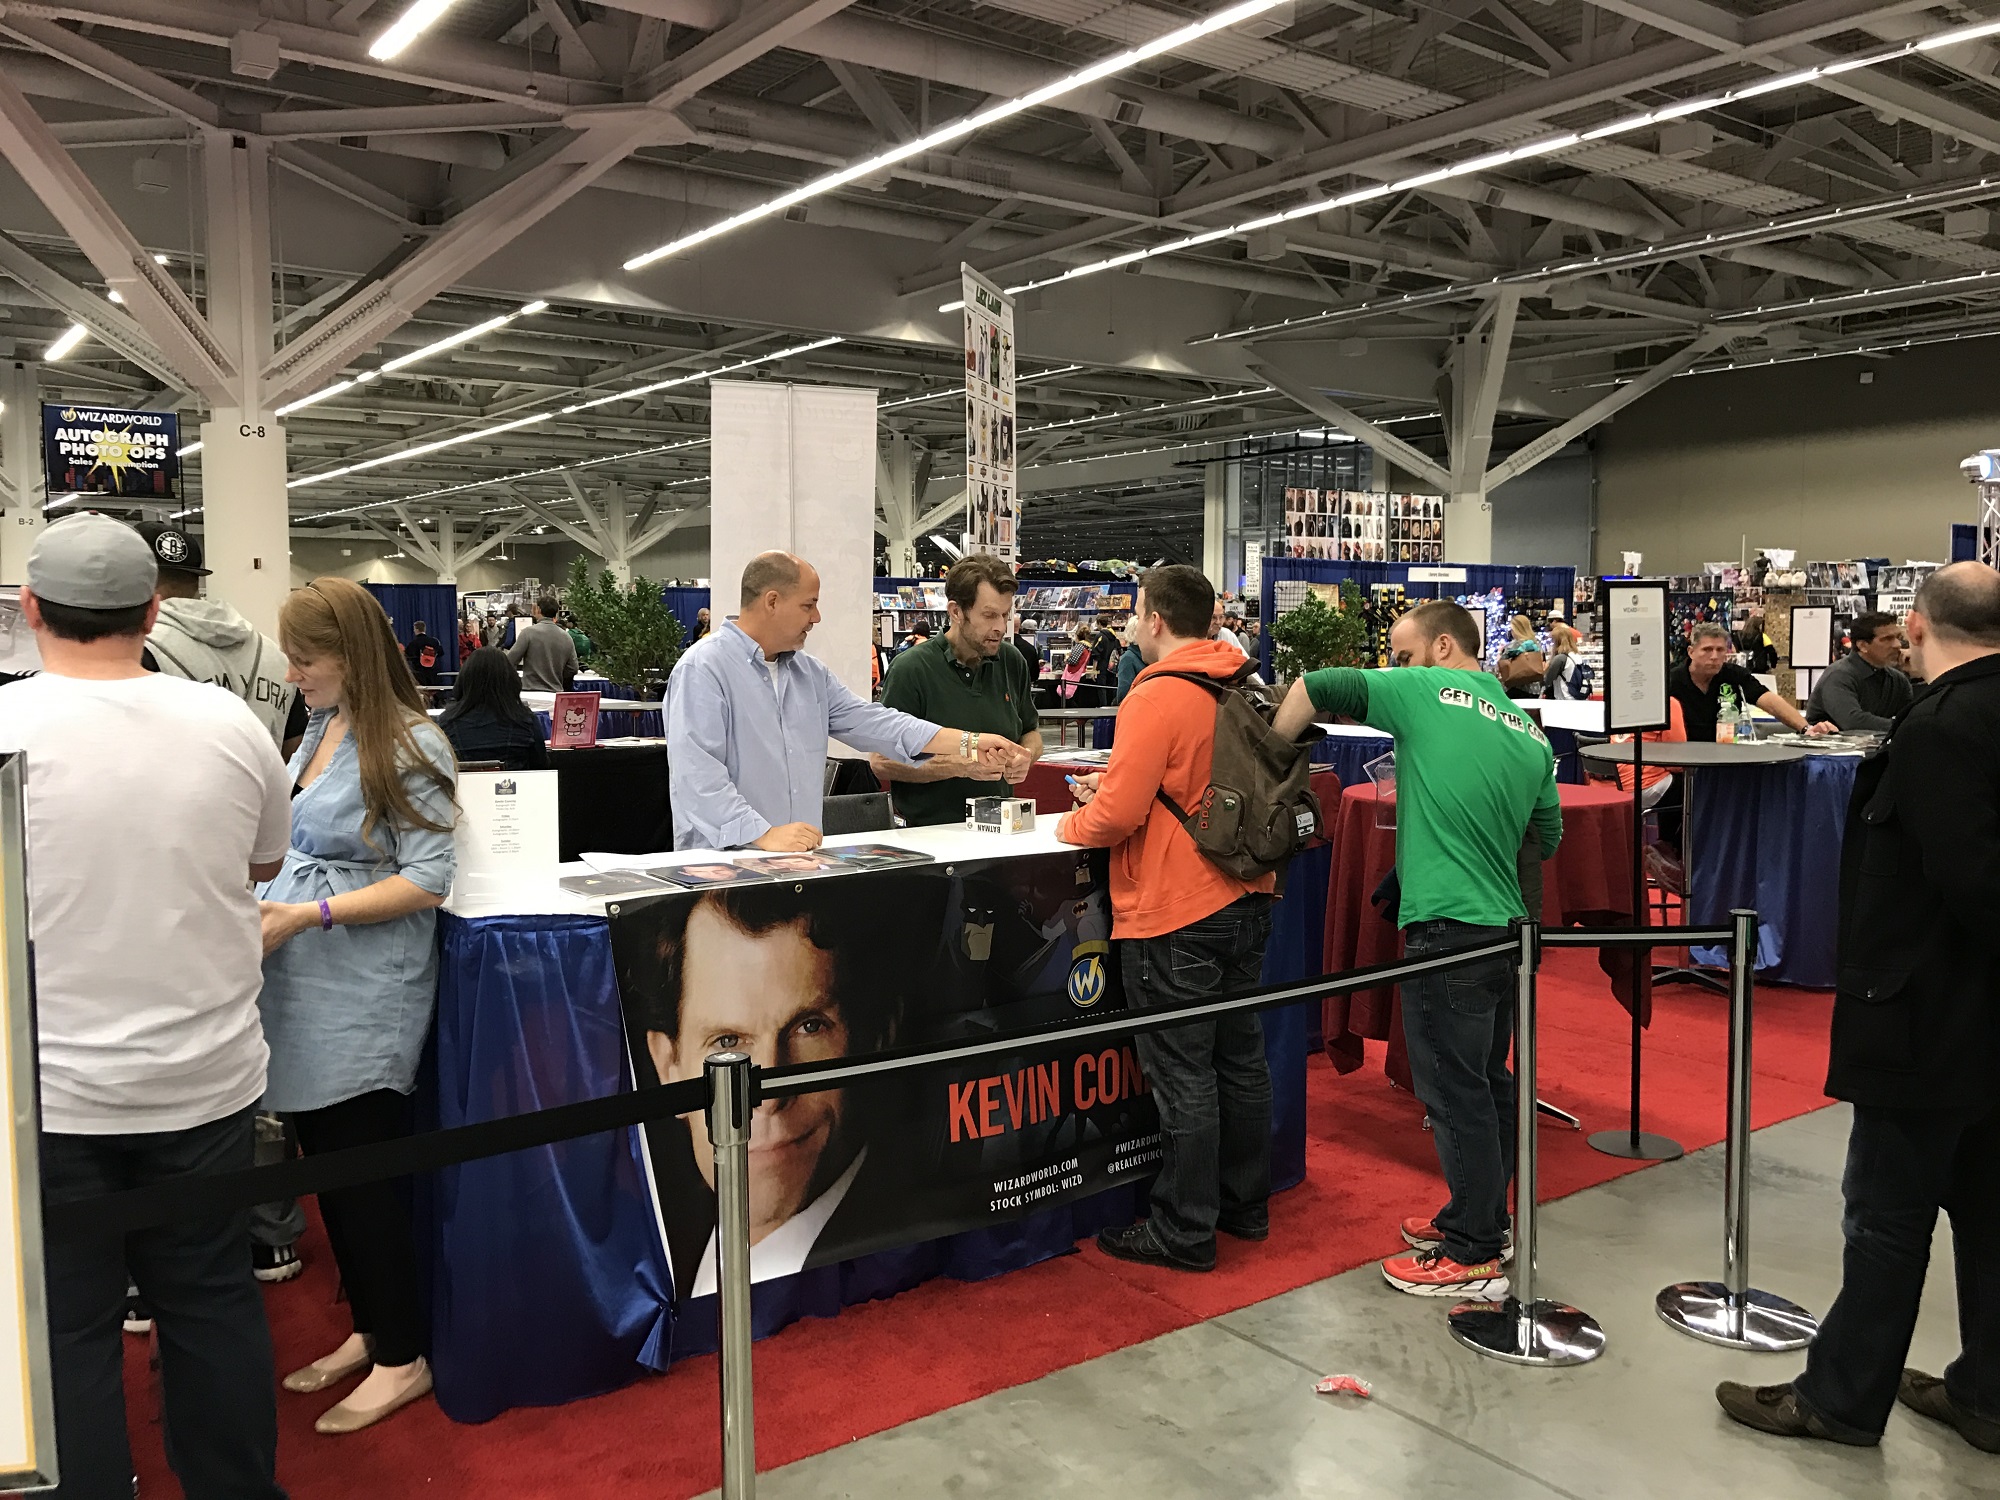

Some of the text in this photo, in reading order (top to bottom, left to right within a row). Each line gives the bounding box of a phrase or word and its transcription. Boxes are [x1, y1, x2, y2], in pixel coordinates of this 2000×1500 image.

[77, 411, 162, 426] WIZARDWORLD
[54, 428, 168, 446] AUTOGRAPH
[240, 424, 265, 438] C-8
[60, 442, 166, 460] PHOTO OPS
[68, 456, 93, 466] Sales
[18, 518, 34, 526] B-2
[170, 539, 178, 554] B
[240, 674, 289, 714] YORK
[1440, 687, 1471, 705] GET
[1479, 698, 1496, 718] TO
[1500, 711, 1524, 730] THE
[978, 824, 1000, 834] BATMAN
[949, 1046, 1151, 1143] KEVIN CON
[994, 1157, 1078, 1193] WIZARDWORLD.COM
[990, 1174, 1083, 1212] STOCK SYMBOL: WIZD
